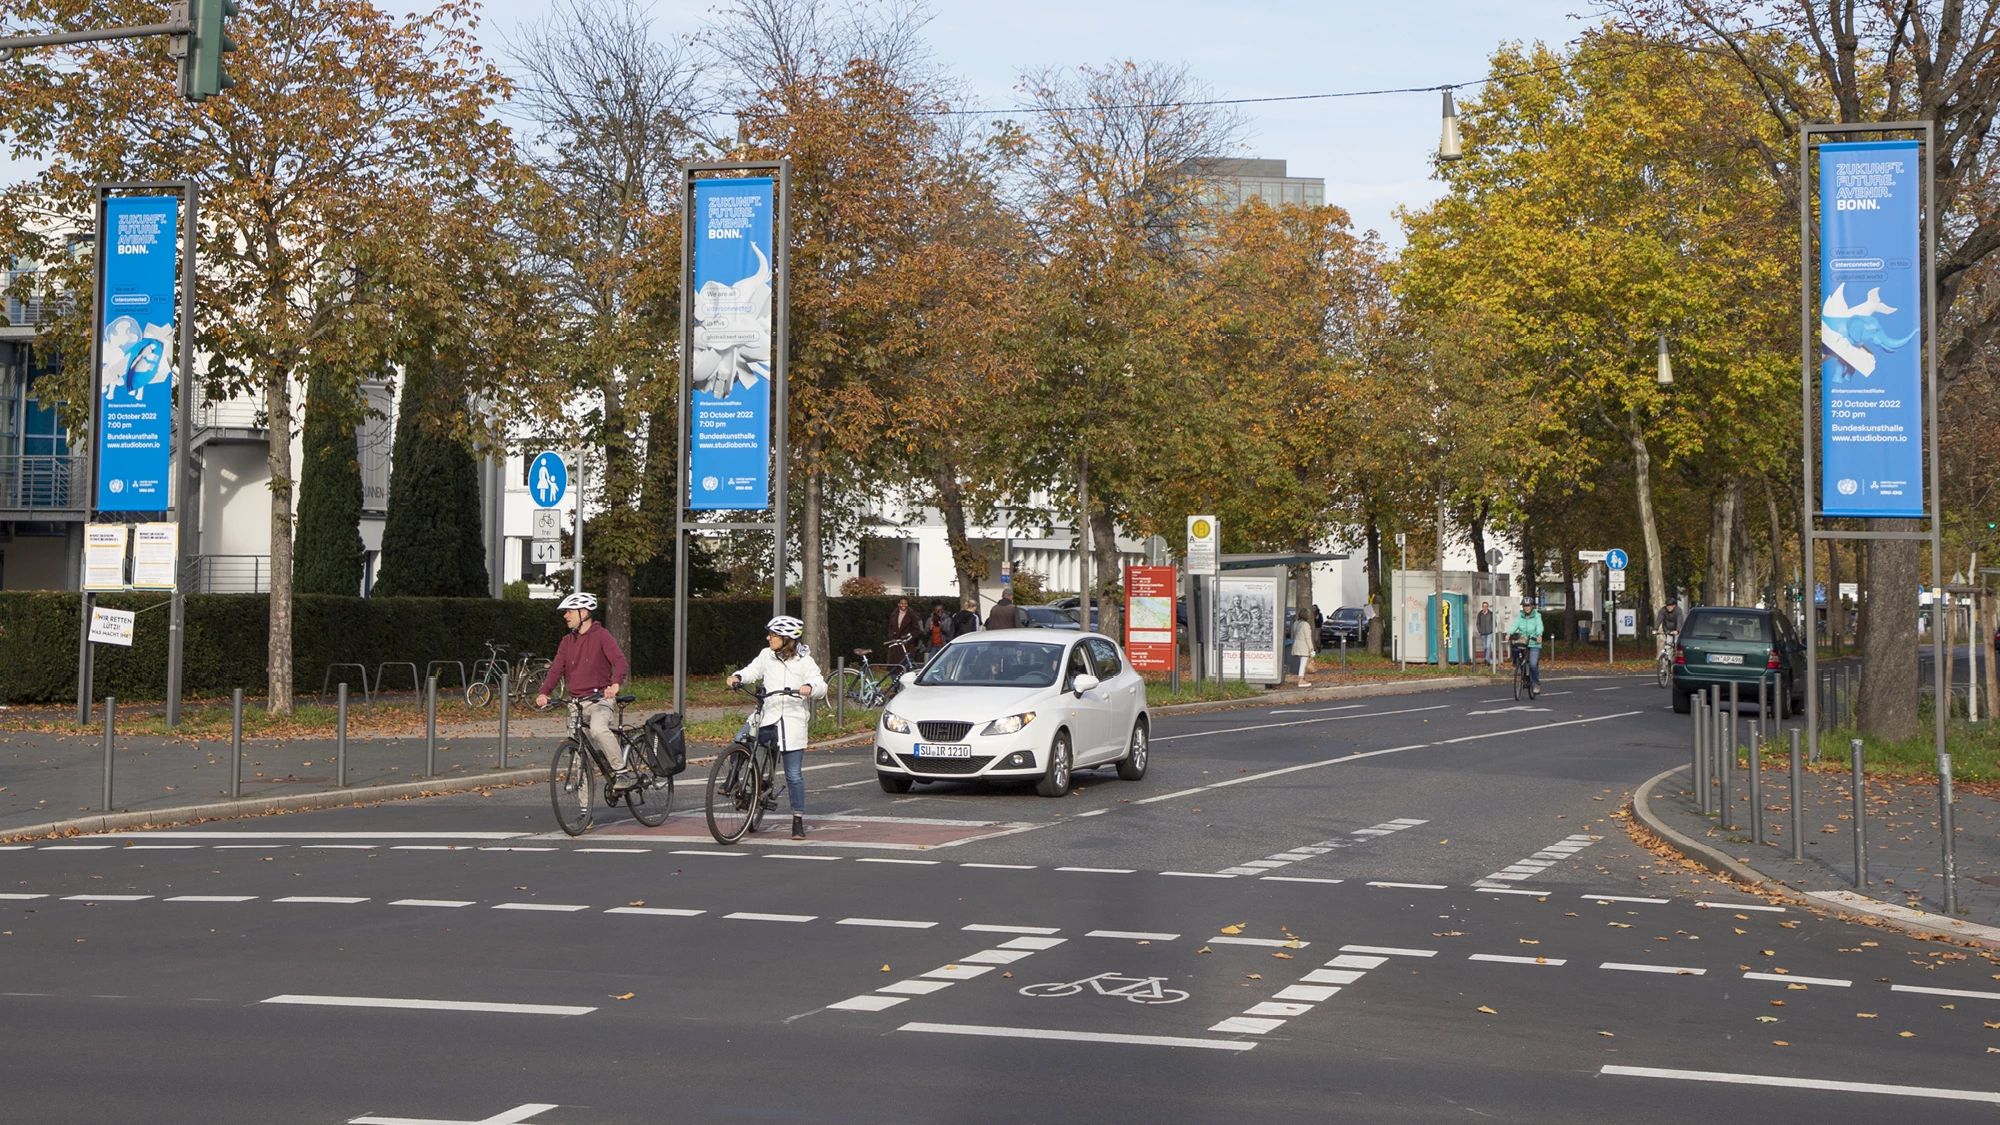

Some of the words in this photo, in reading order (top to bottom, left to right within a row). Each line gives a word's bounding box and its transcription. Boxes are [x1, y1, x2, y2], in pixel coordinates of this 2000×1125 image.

[1836, 162, 1904, 174] ZUKUNFT.
[1836, 174, 1896, 187] FUTURE.
[1836, 187, 1892, 199] AVENIR.
[708, 196, 762, 208] ZUKUNFT.
[1837, 199, 1880, 210] BONN.
[708, 207, 755, 218] FUTURE.
[118, 214, 167, 225] ZUKUNFT.
[708, 218, 752, 228] AVENIR.
[118, 224, 161, 235] FUTURE.
[709, 229, 742, 239] BONN.
[118, 234, 158, 244] AVENIR.
[118, 245, 149, 254] BONN.
[921, 746, 931, 755] SU
[937, 746, 945, 756] IR
[948, 747, 968, 756] 1210
